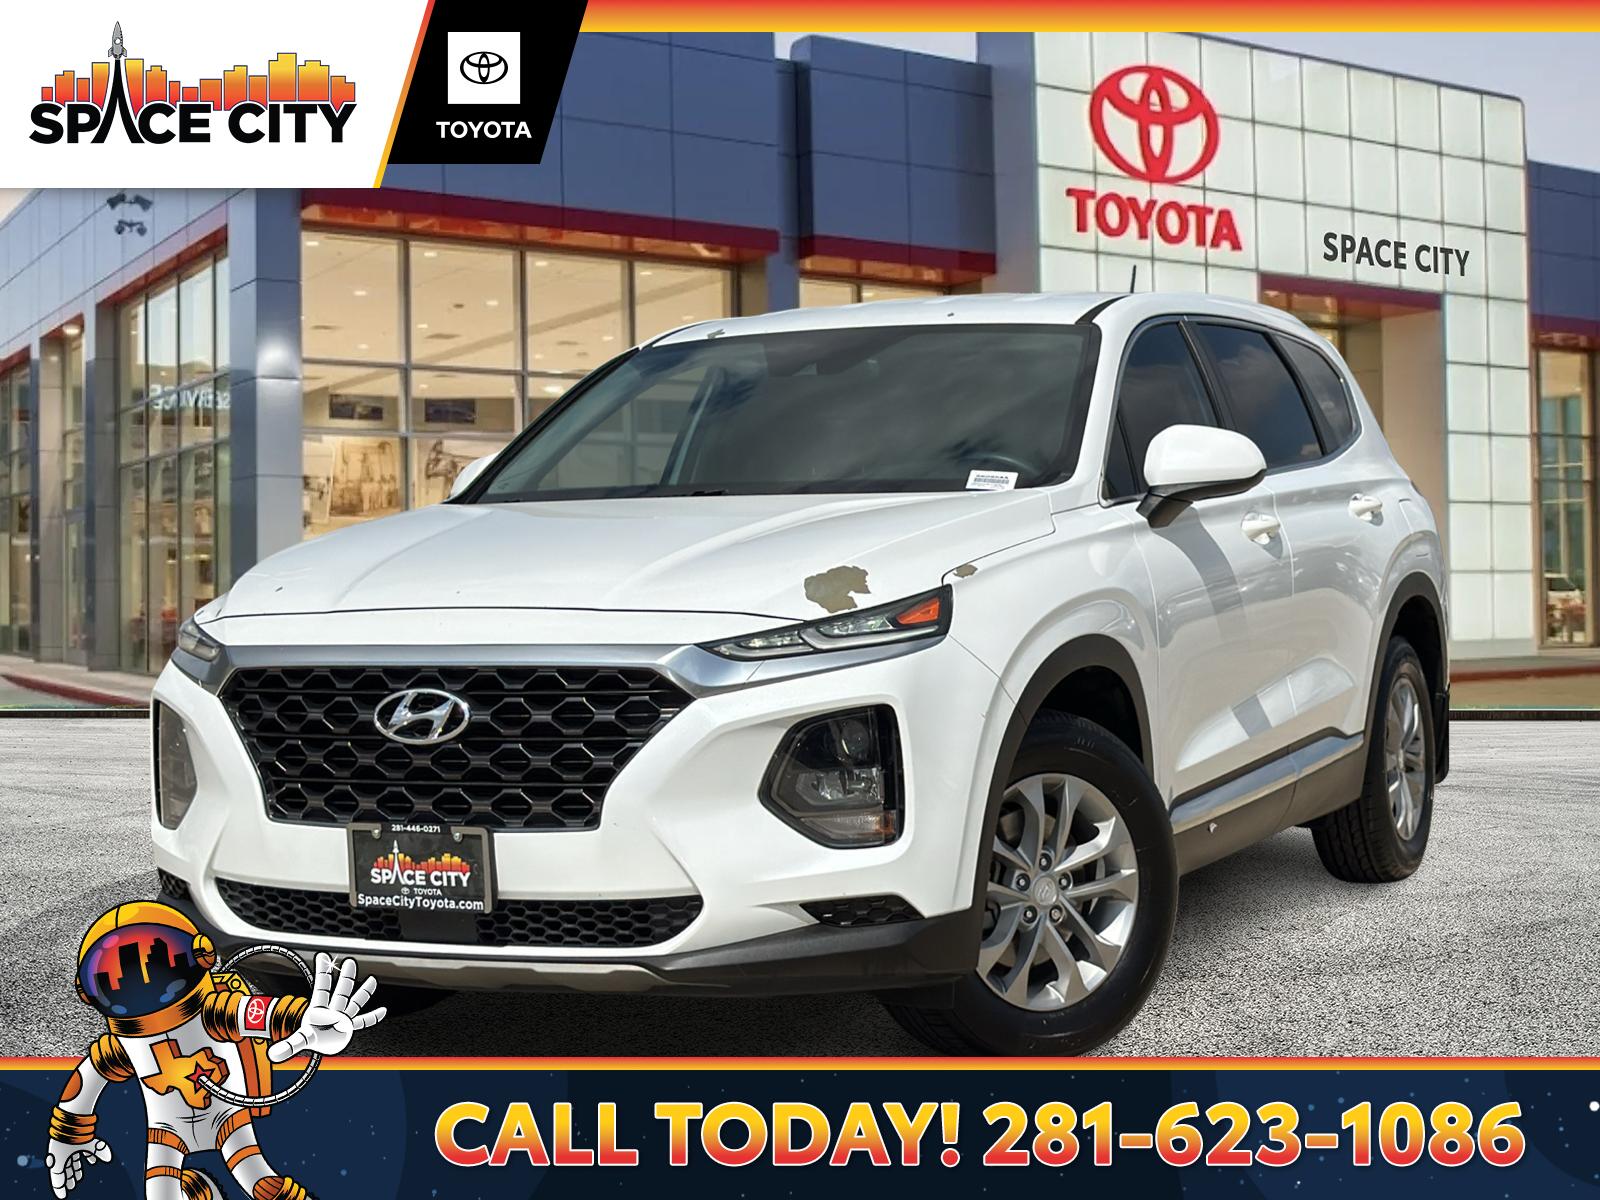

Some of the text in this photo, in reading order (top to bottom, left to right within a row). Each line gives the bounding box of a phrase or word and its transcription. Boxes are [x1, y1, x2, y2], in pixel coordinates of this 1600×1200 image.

[1066, 187, 1242, 251] TOYOTA
[1323, 231, 1470, 277] SPACE CITY
[370, 862, 471, 887] SPACE CITY
[357, 893, 484, 911] SpaceCityToyota.com
[413, 887, 443, 896] TOYOTA
